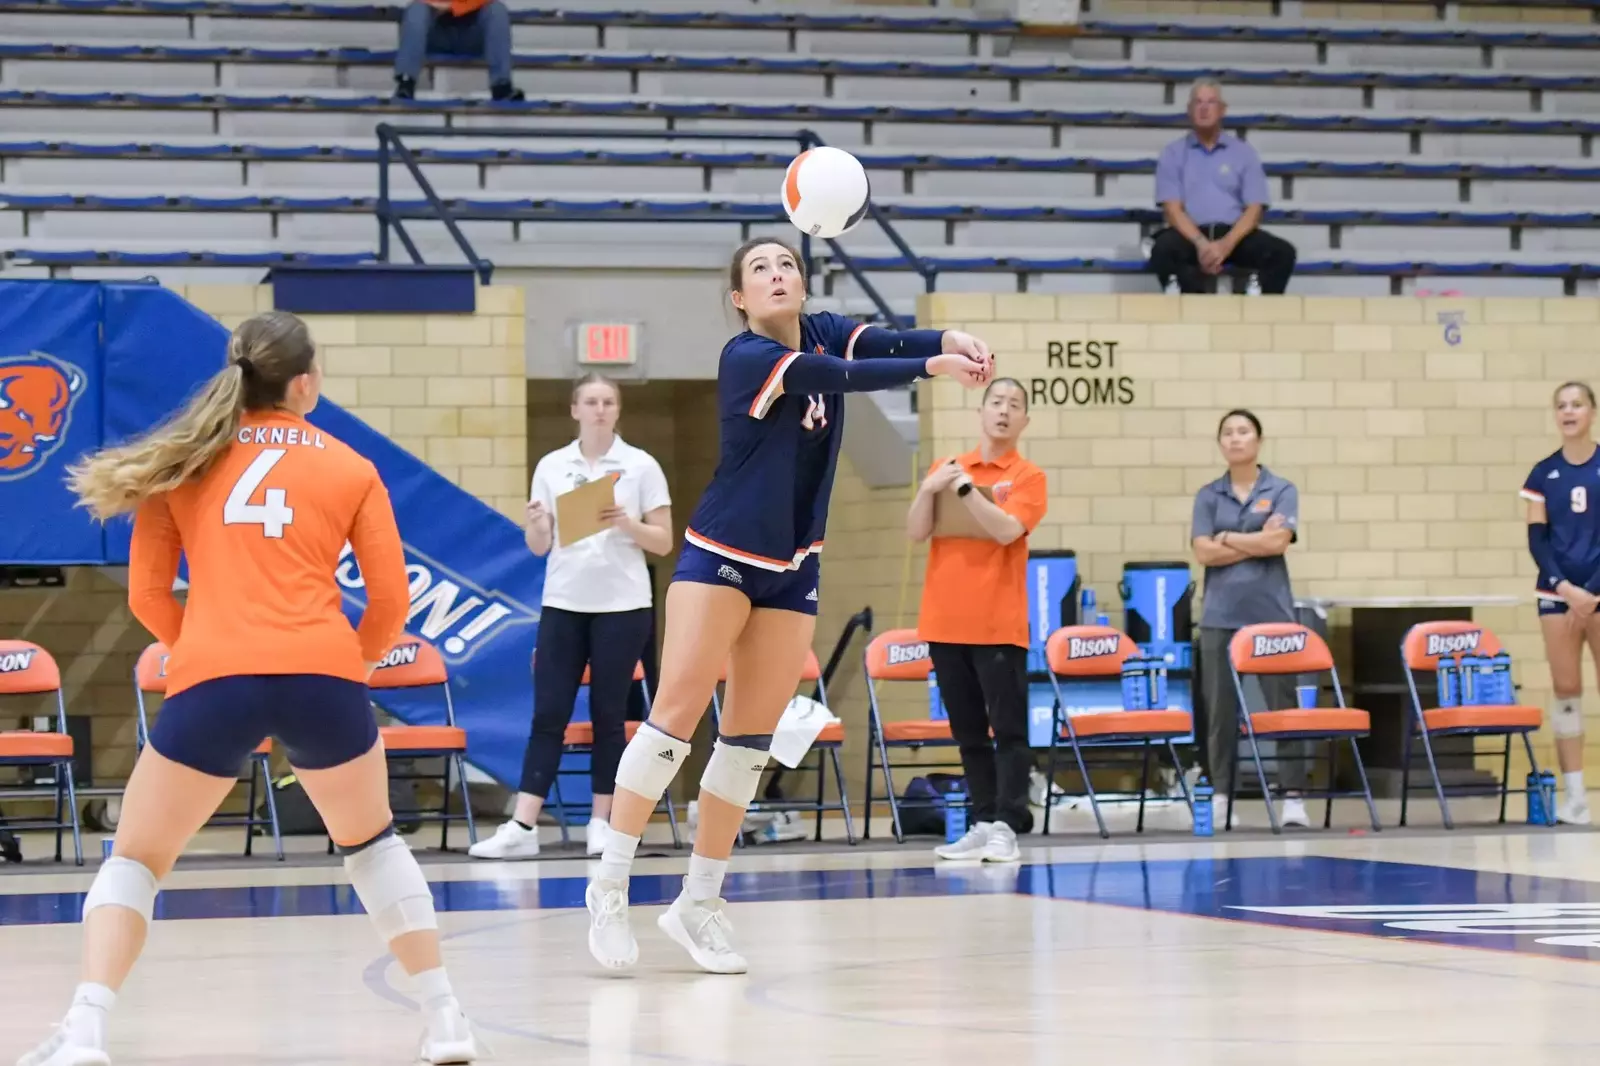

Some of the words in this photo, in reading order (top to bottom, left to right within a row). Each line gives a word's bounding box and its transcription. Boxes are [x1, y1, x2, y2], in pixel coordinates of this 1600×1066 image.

[587, 325, 629, 361] EXIT
[1047, 341, 1118, 369] REST
[1031, 377, 1135, 405] ROOMS
[238, 427, 326, 449] CKNELL
[223, 448, 294, 538] 4
[1570, 486, 1588, 513] 9
[1069, 636, 1119, 660] BISON
[1253, 633, 1305, 656] BISON
[1427, 632, 1480, 655] BISON
[0, 652, 32, 672] ON
[377, 645, 417, 668] SON
